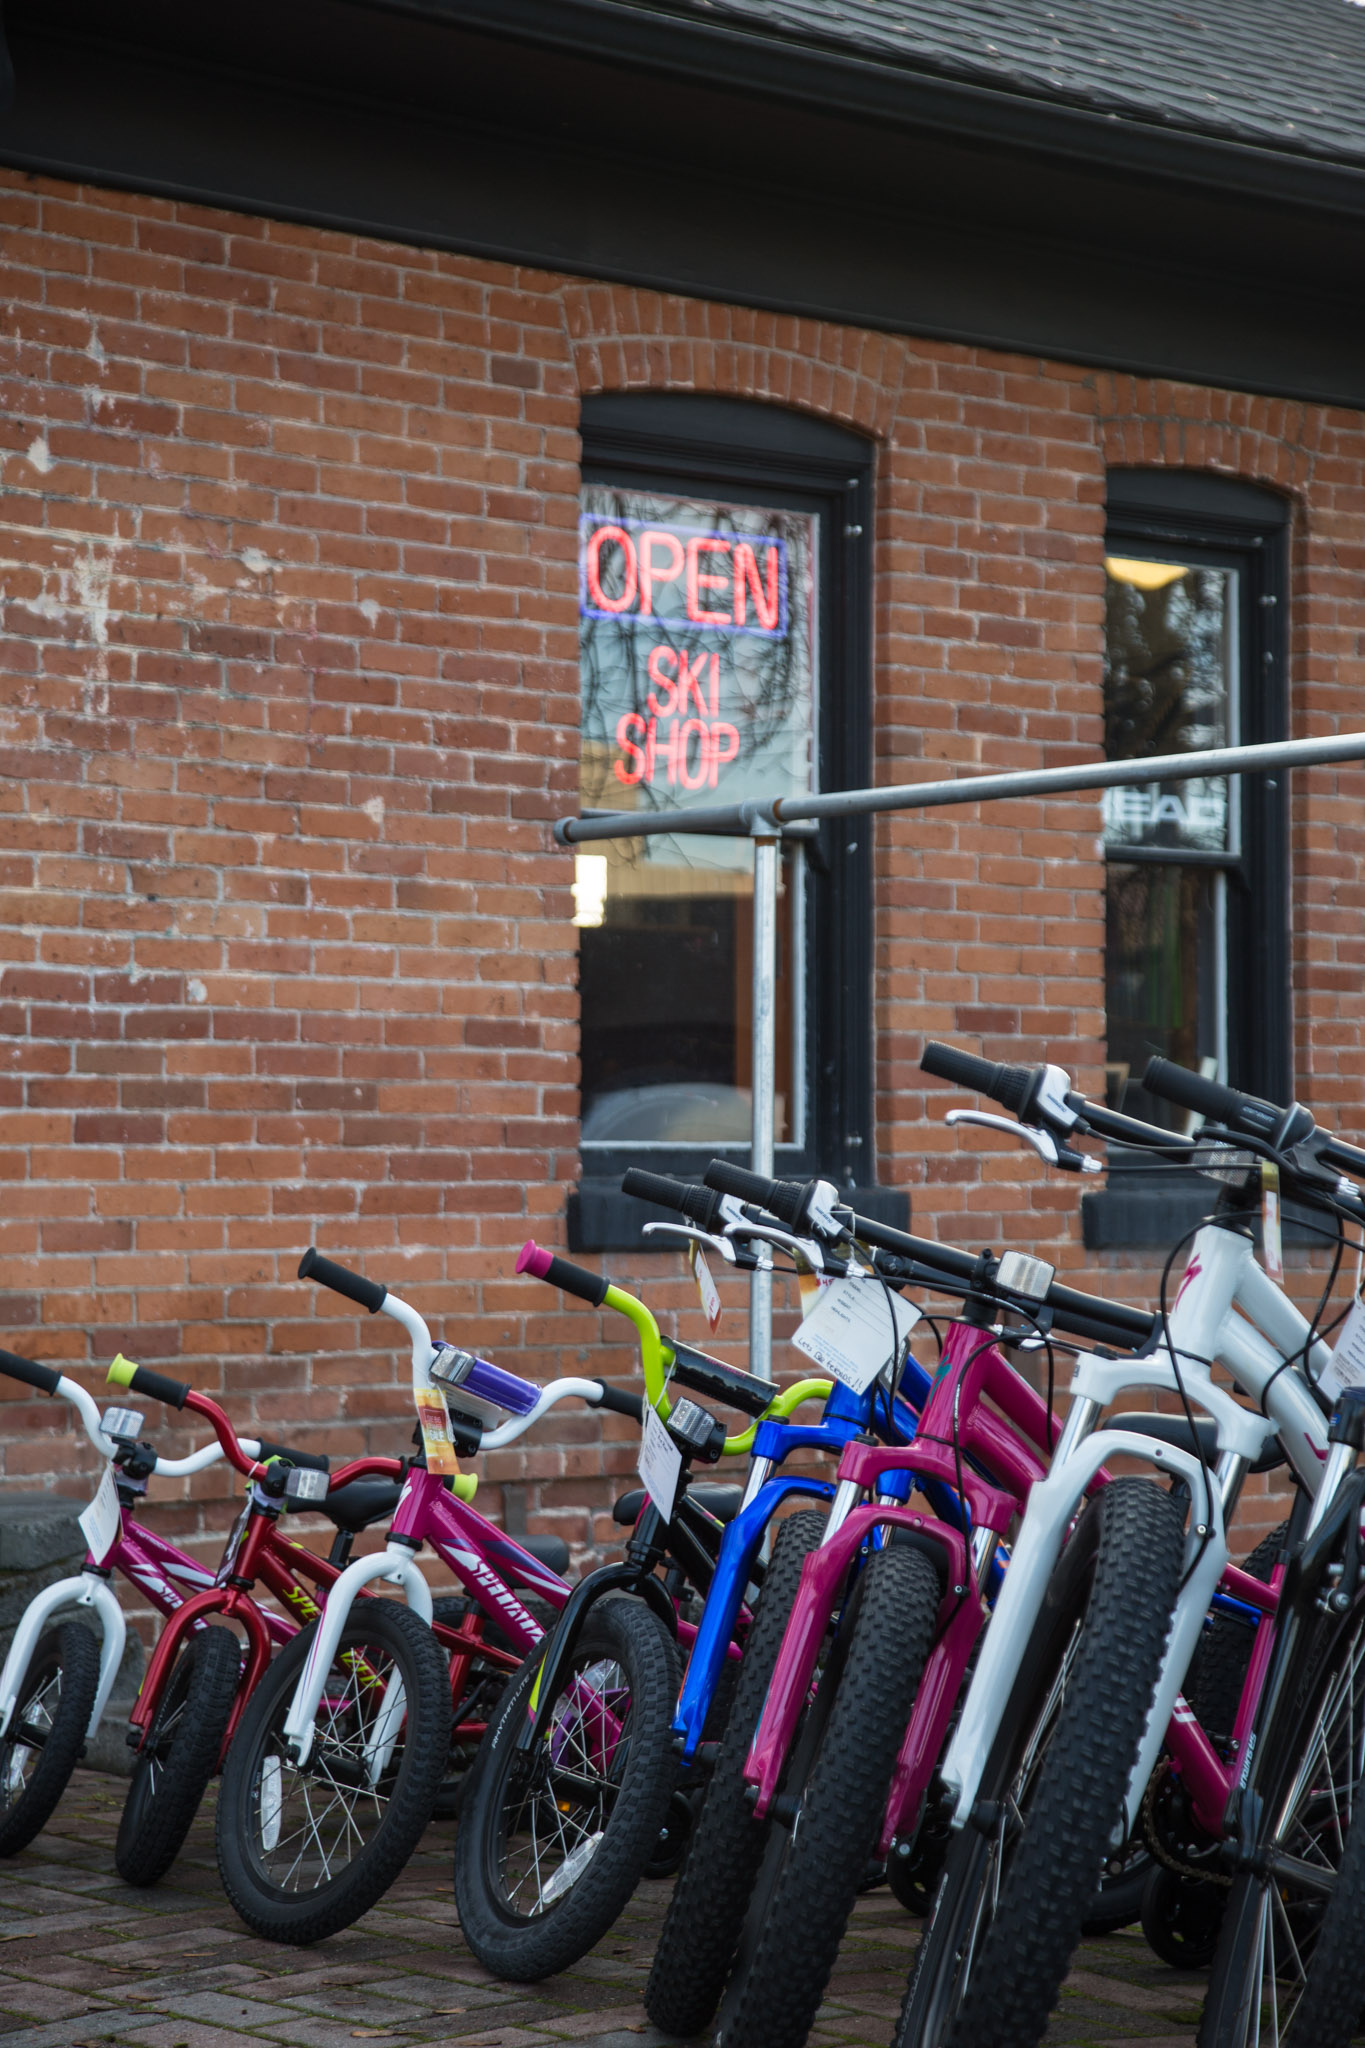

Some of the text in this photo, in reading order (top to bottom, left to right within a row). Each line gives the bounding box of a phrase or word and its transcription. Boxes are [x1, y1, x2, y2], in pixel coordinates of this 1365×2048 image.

[587, 526, 779, 630] OPEN
[647, 645, 720, 718] SKI
[614, 712, 740, 789] SHOP
[1103, 785, 1228, 826] EAD
